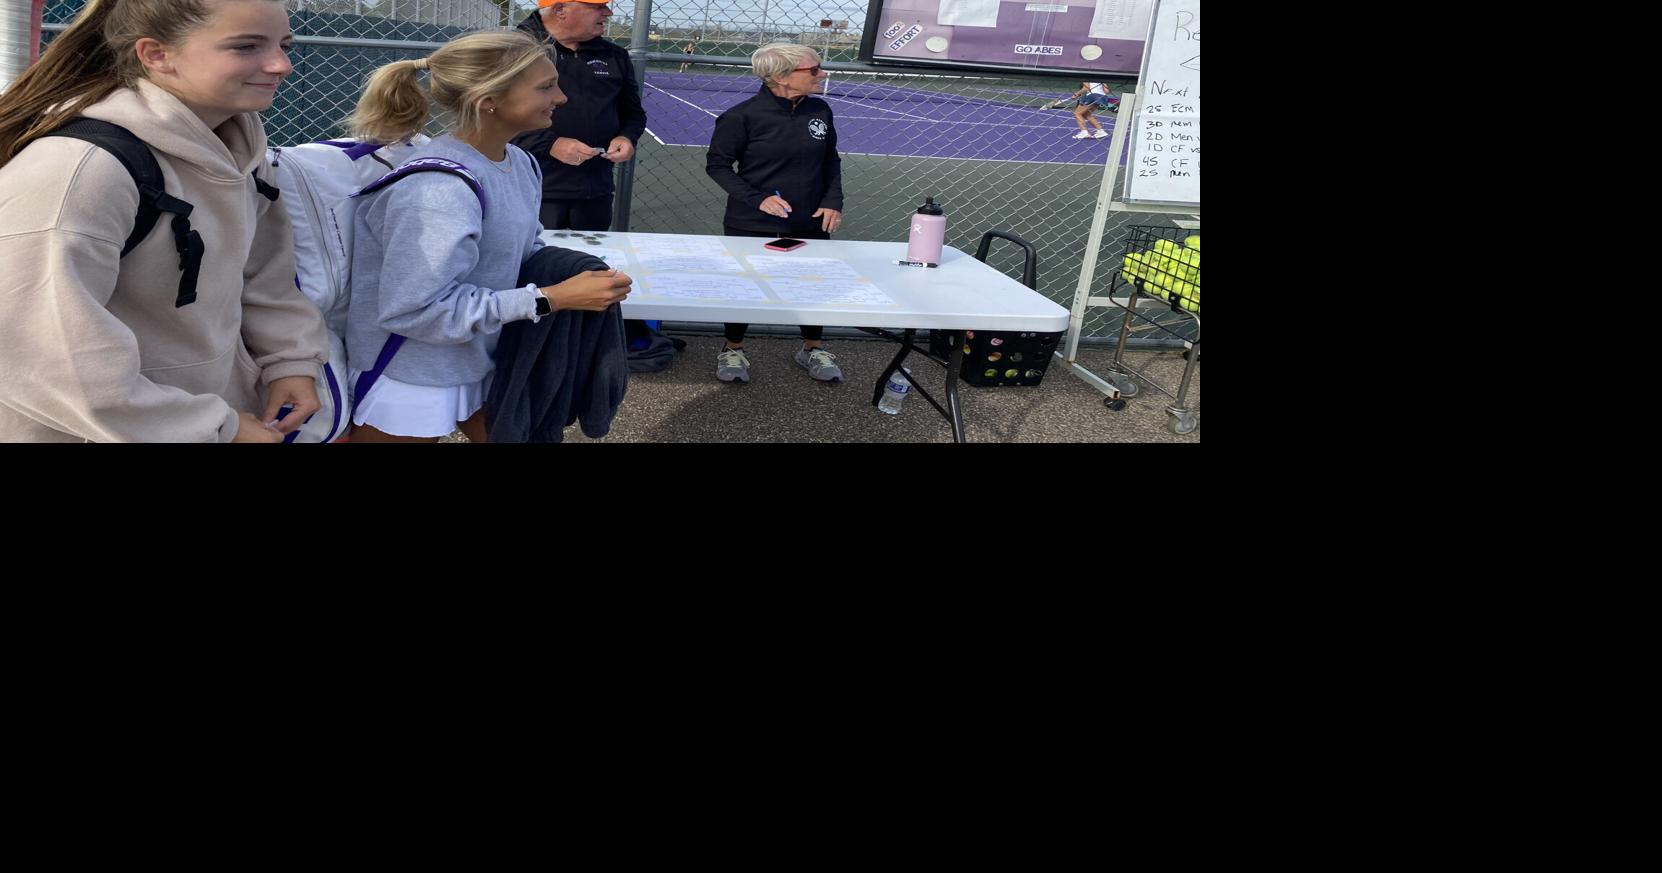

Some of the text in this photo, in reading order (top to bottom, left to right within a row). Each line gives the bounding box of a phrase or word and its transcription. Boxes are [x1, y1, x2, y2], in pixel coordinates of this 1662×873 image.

[889, 25, 920, 51] EFFORT
[1015, 45, 1061, 54] GO ABES
[1146, 131, 1193, 142] 2D Men
[1170, 144, 1186, 153] CF
